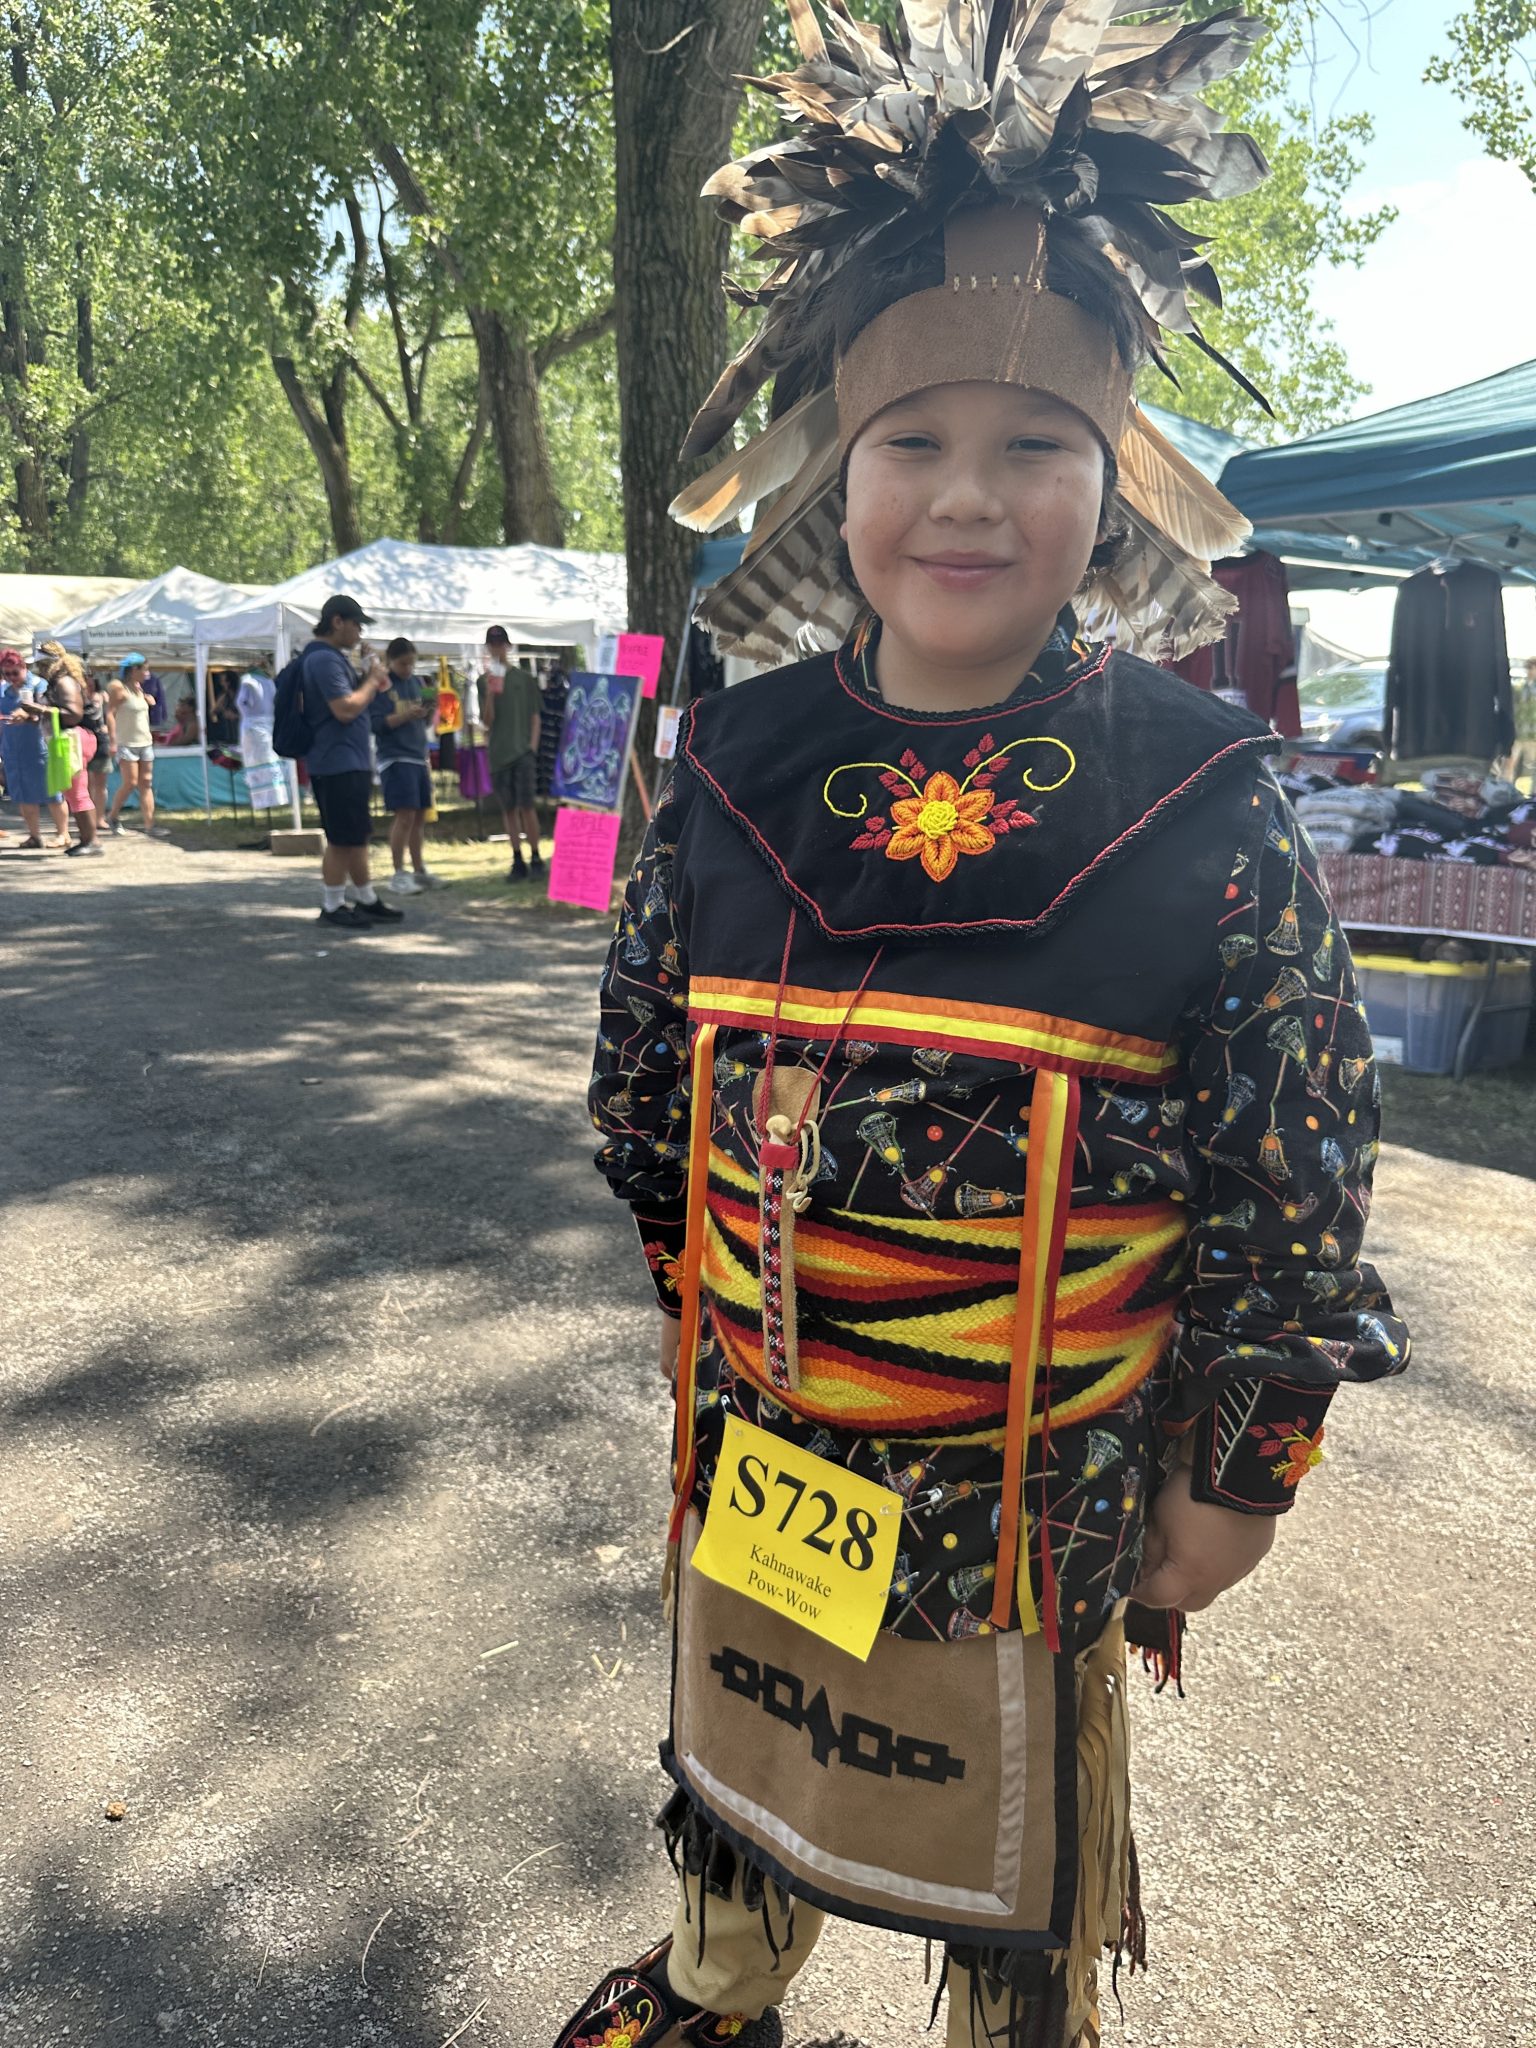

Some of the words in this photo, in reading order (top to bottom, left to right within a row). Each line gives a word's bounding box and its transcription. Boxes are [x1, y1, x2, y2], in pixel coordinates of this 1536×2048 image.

[729, 1454, 878, 1572] S728
[747, 1570, 822, 1620] Pow-Wow
[750, 1543, 832, 1598] Kahnawake
